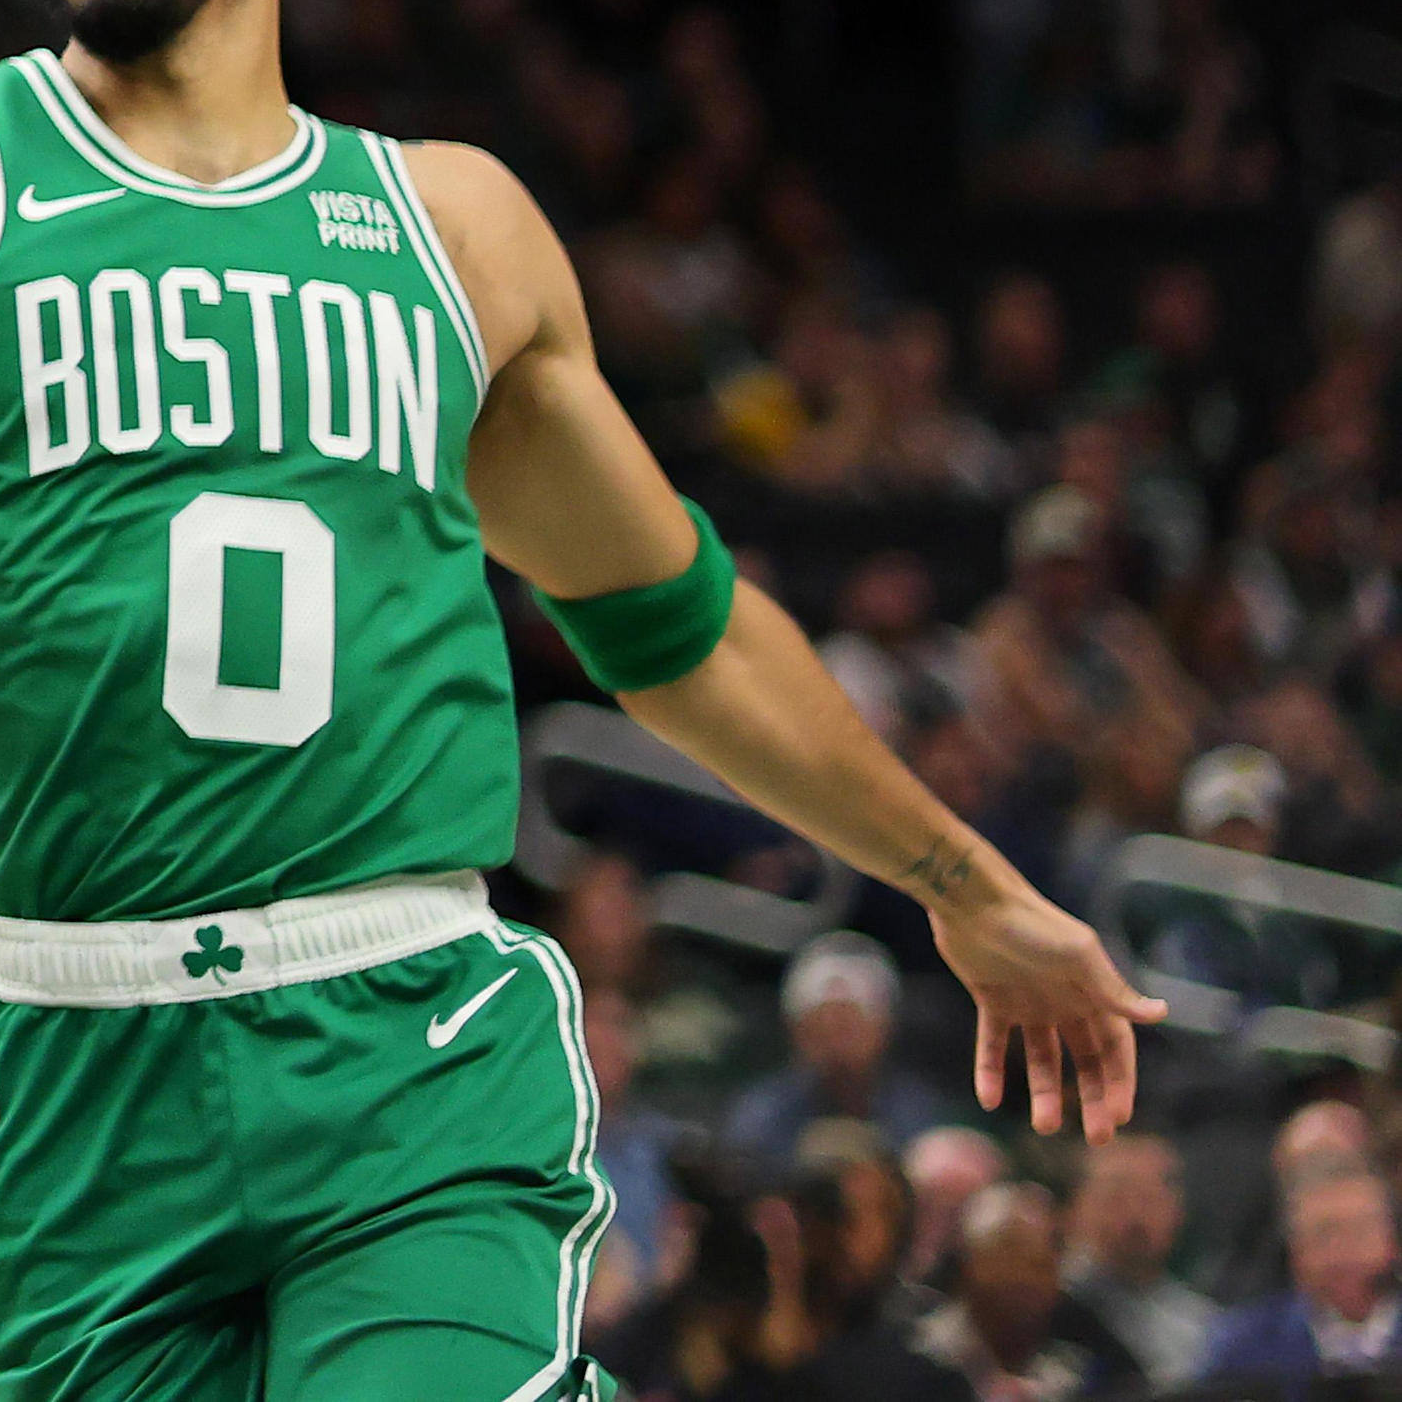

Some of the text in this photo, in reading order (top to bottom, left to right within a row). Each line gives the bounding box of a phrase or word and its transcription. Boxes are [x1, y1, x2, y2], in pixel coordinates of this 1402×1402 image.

[308, 190, 397, 228] VISTA
[317, 218, 400, 255] PRINT
[15, 267, 439, 493] BOSTON
[162, 491, 336, 748] 0
